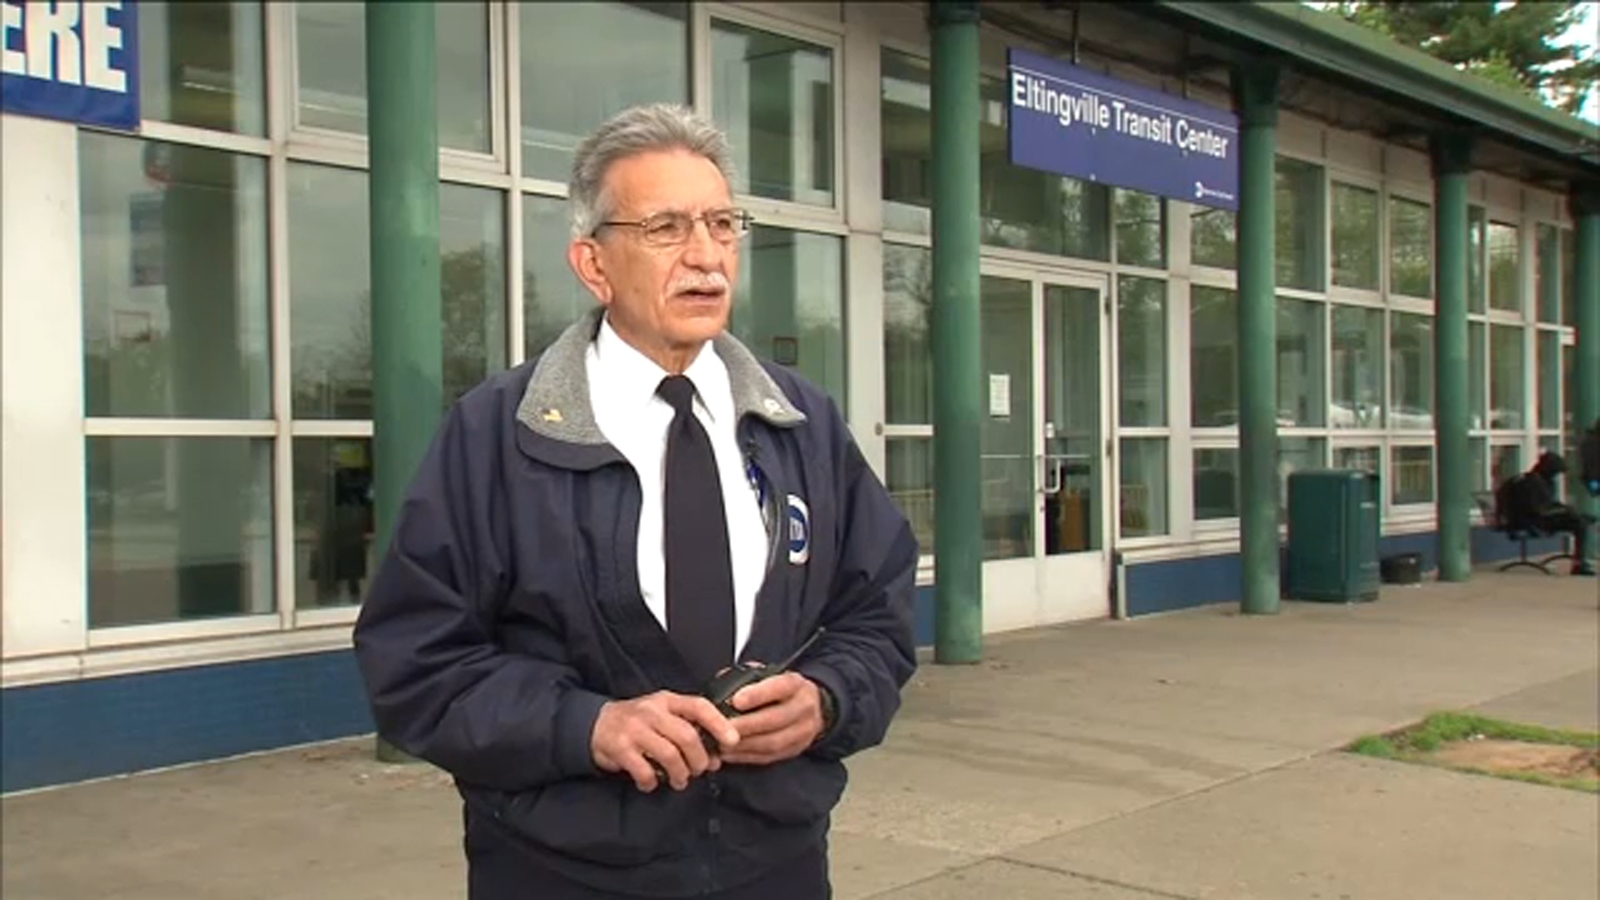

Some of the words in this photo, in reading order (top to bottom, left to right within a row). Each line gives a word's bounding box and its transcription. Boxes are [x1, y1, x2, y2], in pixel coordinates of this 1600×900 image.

[1012, 72, 1110, 127] Eltingville
[1112, 101, 1172, 145] Transit
[1175, 118, 1228, 159] Center
